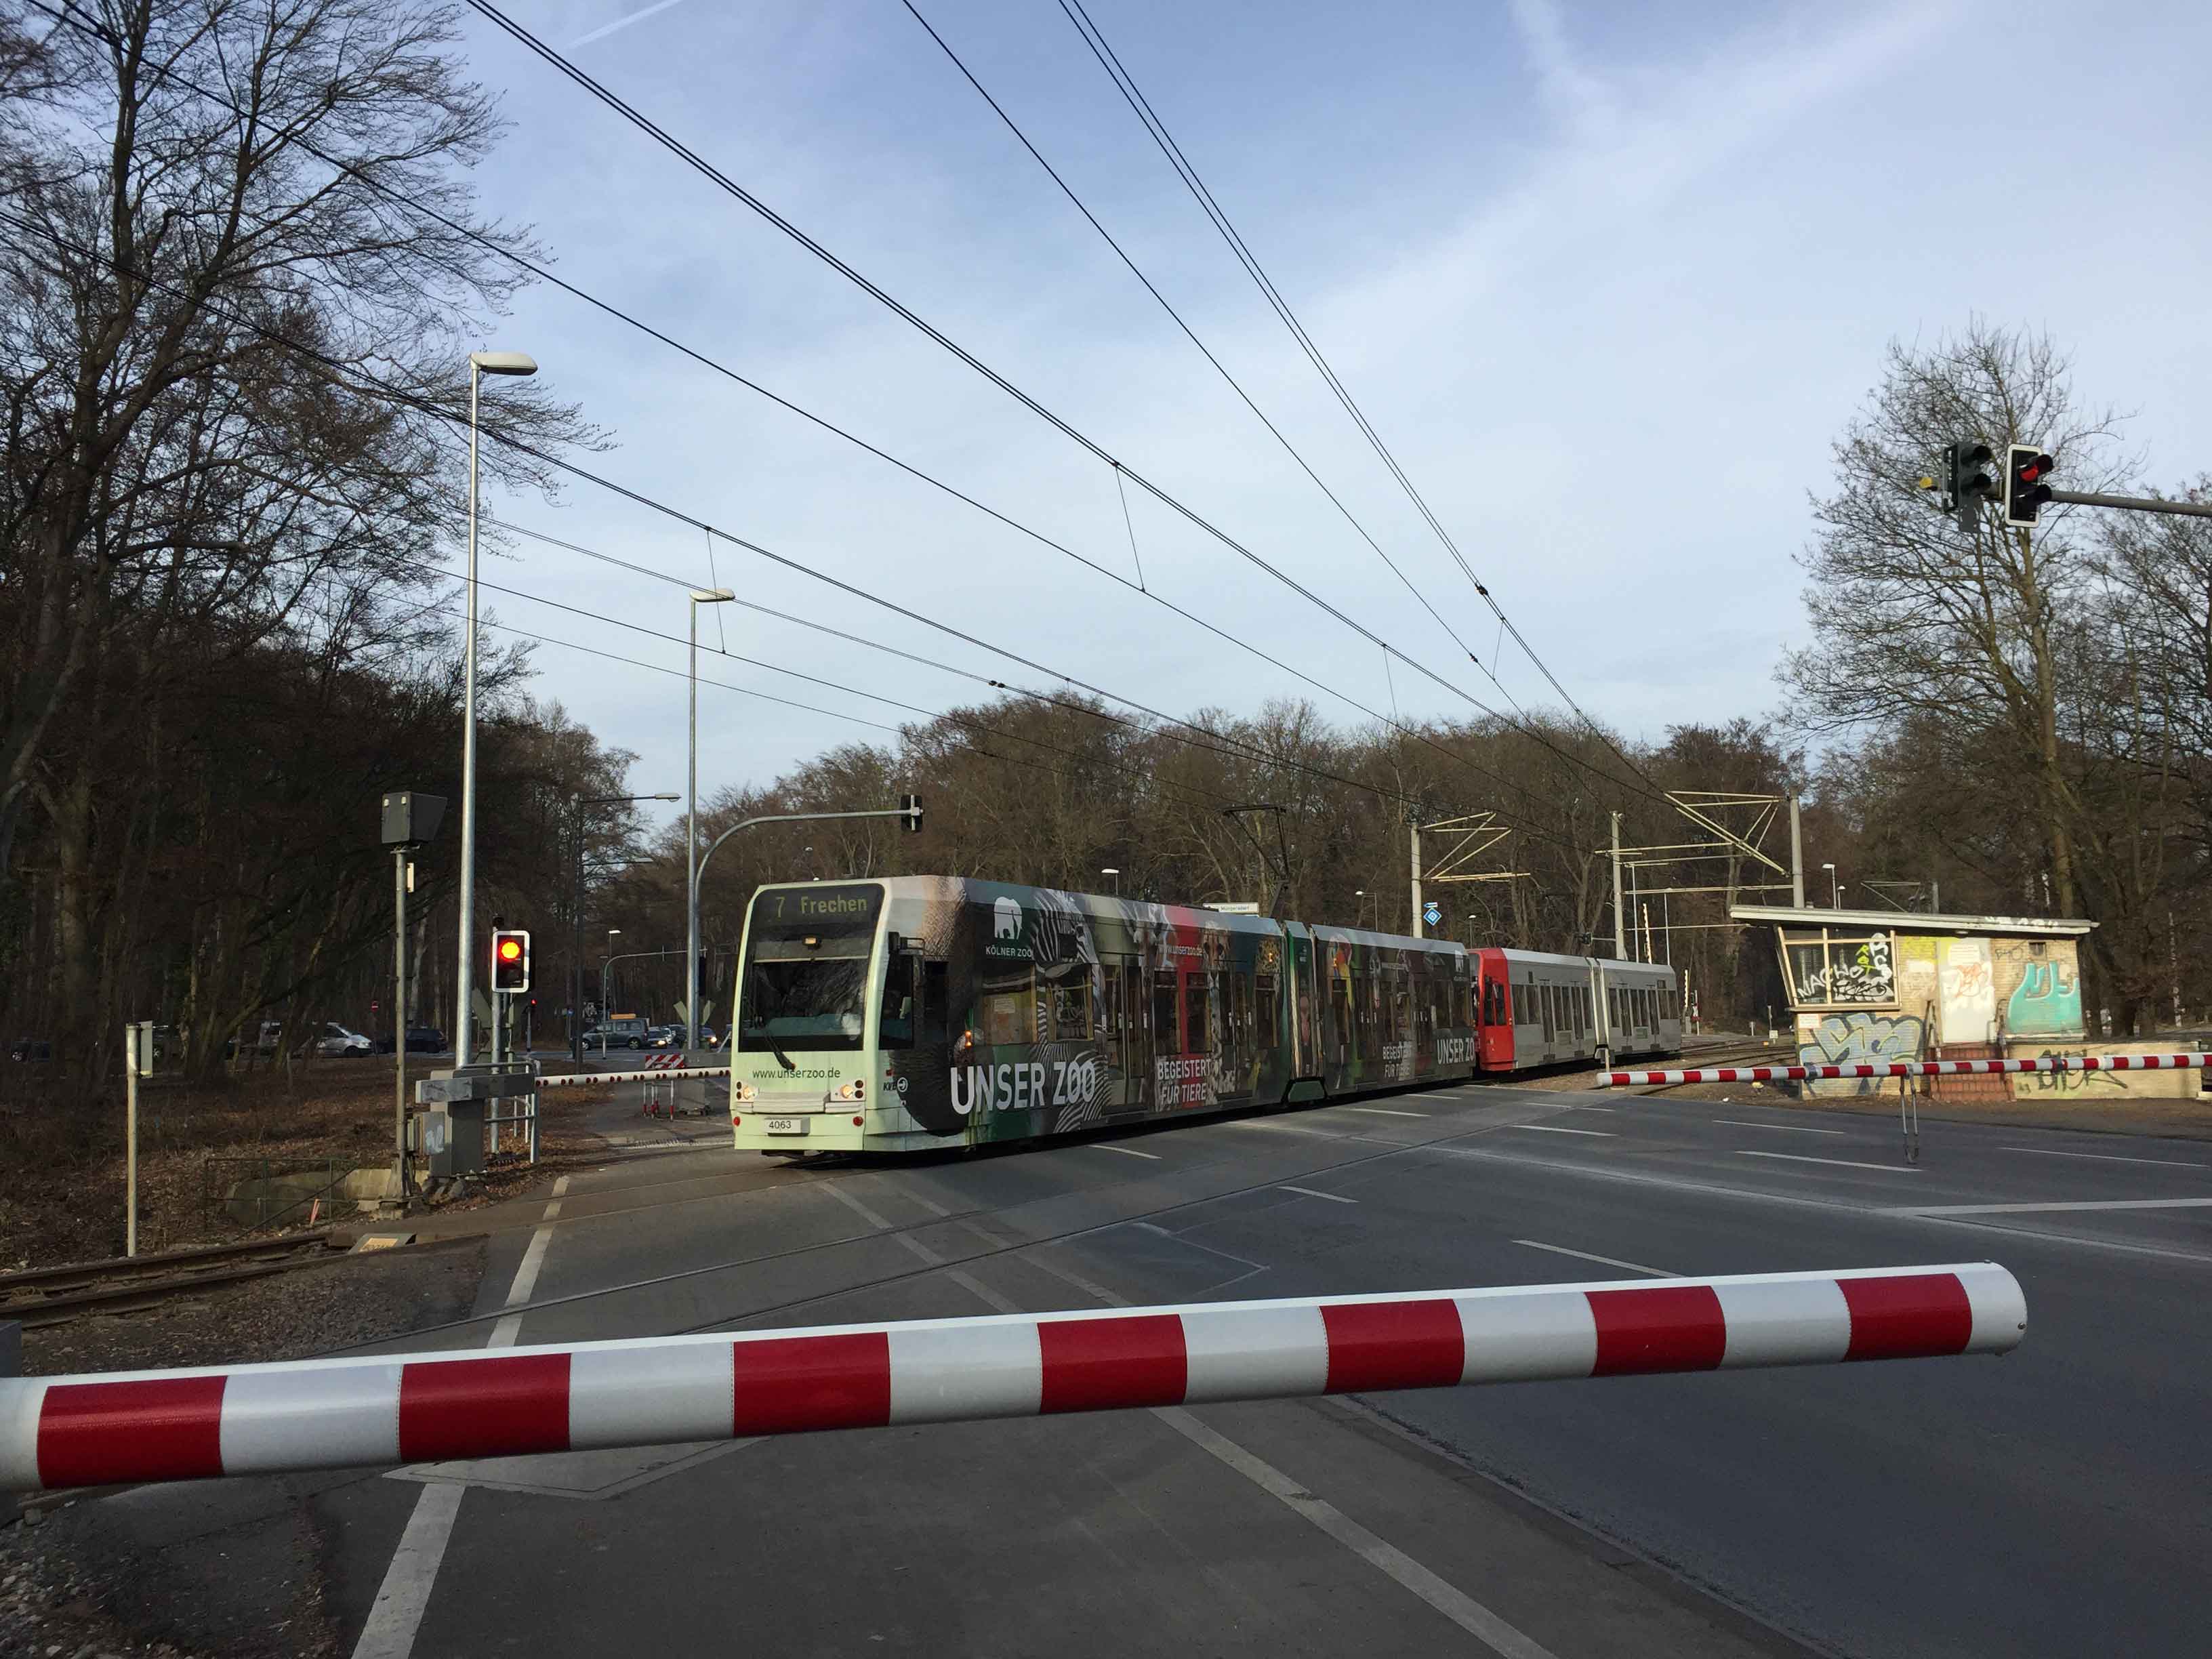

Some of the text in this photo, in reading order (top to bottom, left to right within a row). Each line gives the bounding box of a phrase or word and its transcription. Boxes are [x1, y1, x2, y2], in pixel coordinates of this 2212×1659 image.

[775, 895, 867, 918] 7 Frechen
[985, 945, 1032, 958] KÖLNER ZOO
[1437, 1038, 1464, 1065] UNSER
[752, 1067, 841, 1079] www.unserzoo.de
[1158, 1059, 1212, 1080] BEGEISTERT
[950, 1060, 1096, 1115] UNSER ZOO
[1182, 1083, 1207, 1102] TIERE
[769, 1120, 792, 1129] 4063
